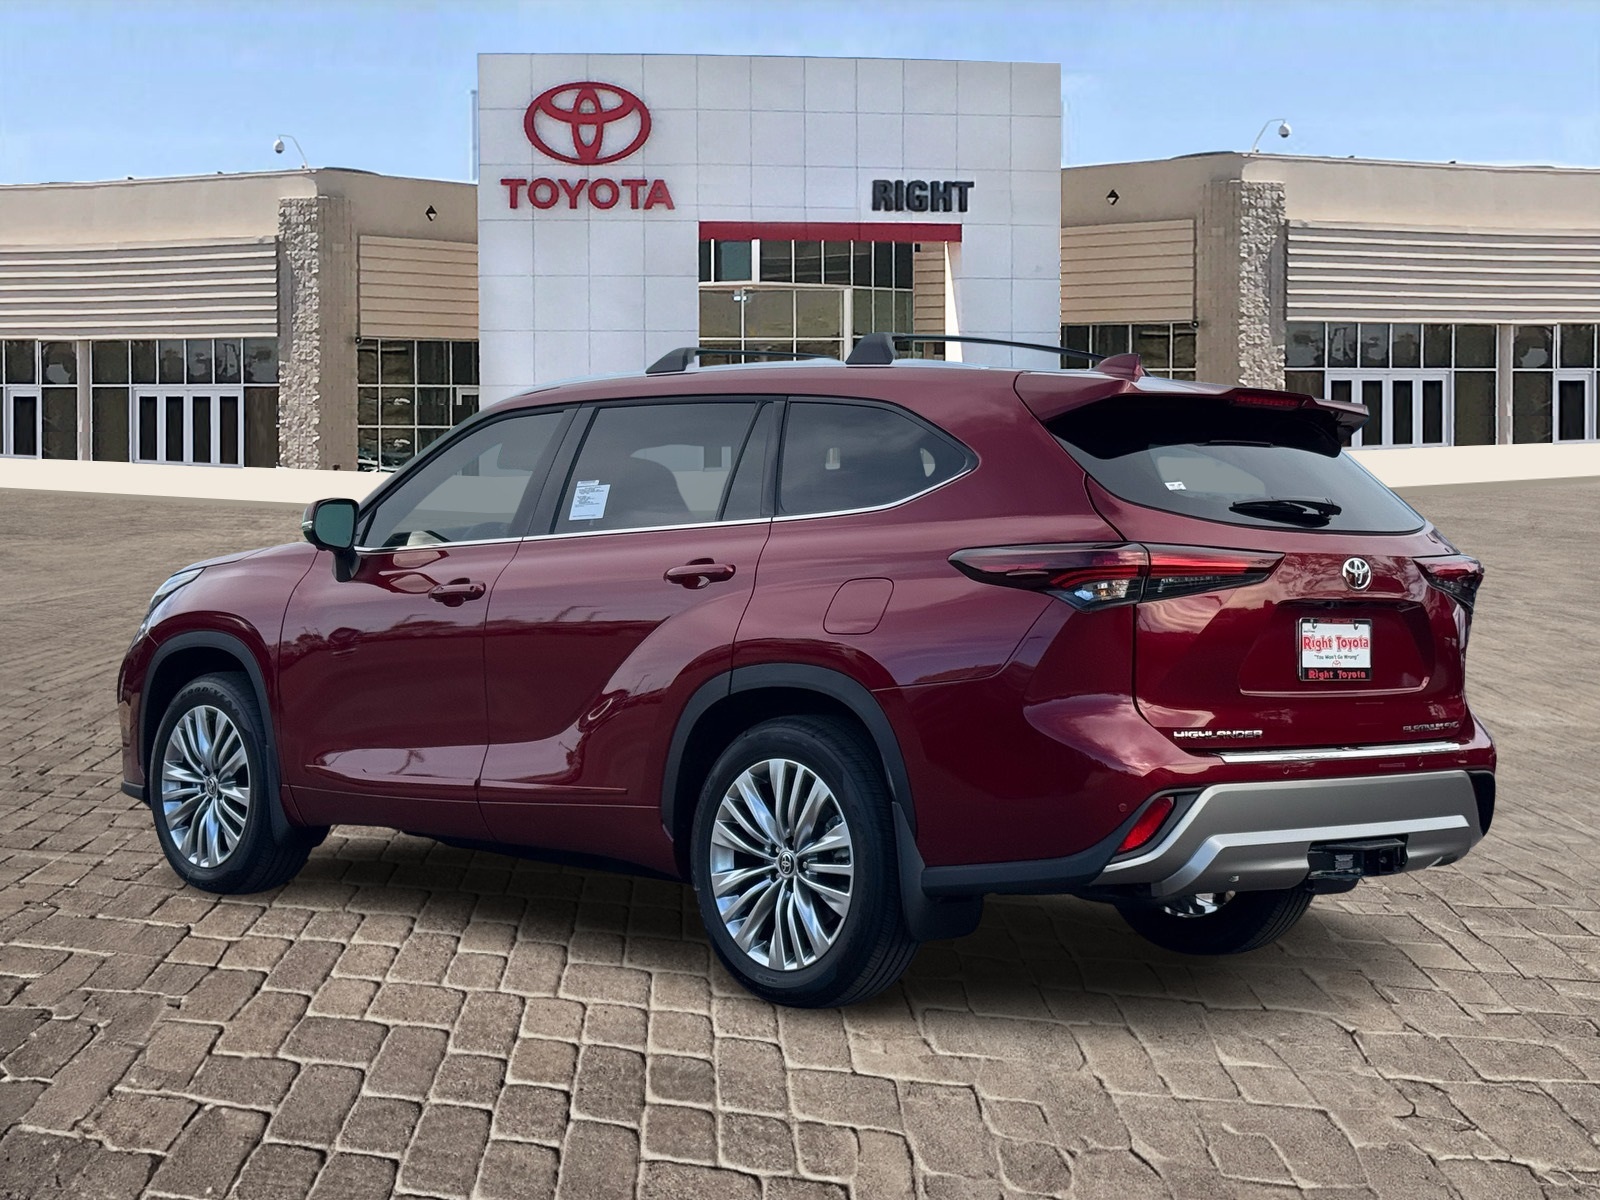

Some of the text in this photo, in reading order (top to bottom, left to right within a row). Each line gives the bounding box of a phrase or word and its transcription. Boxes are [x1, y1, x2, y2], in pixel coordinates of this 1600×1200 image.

[500, 177, 676, 210] TOYOTA
[872, 179, 975, 212] RIGHT
[1302, 634, 1369, 653] Right Toyota
[1308, 669, 1366, 680] Right Toyota
[1173, 730, 1263, 739] HIGHLANDER
